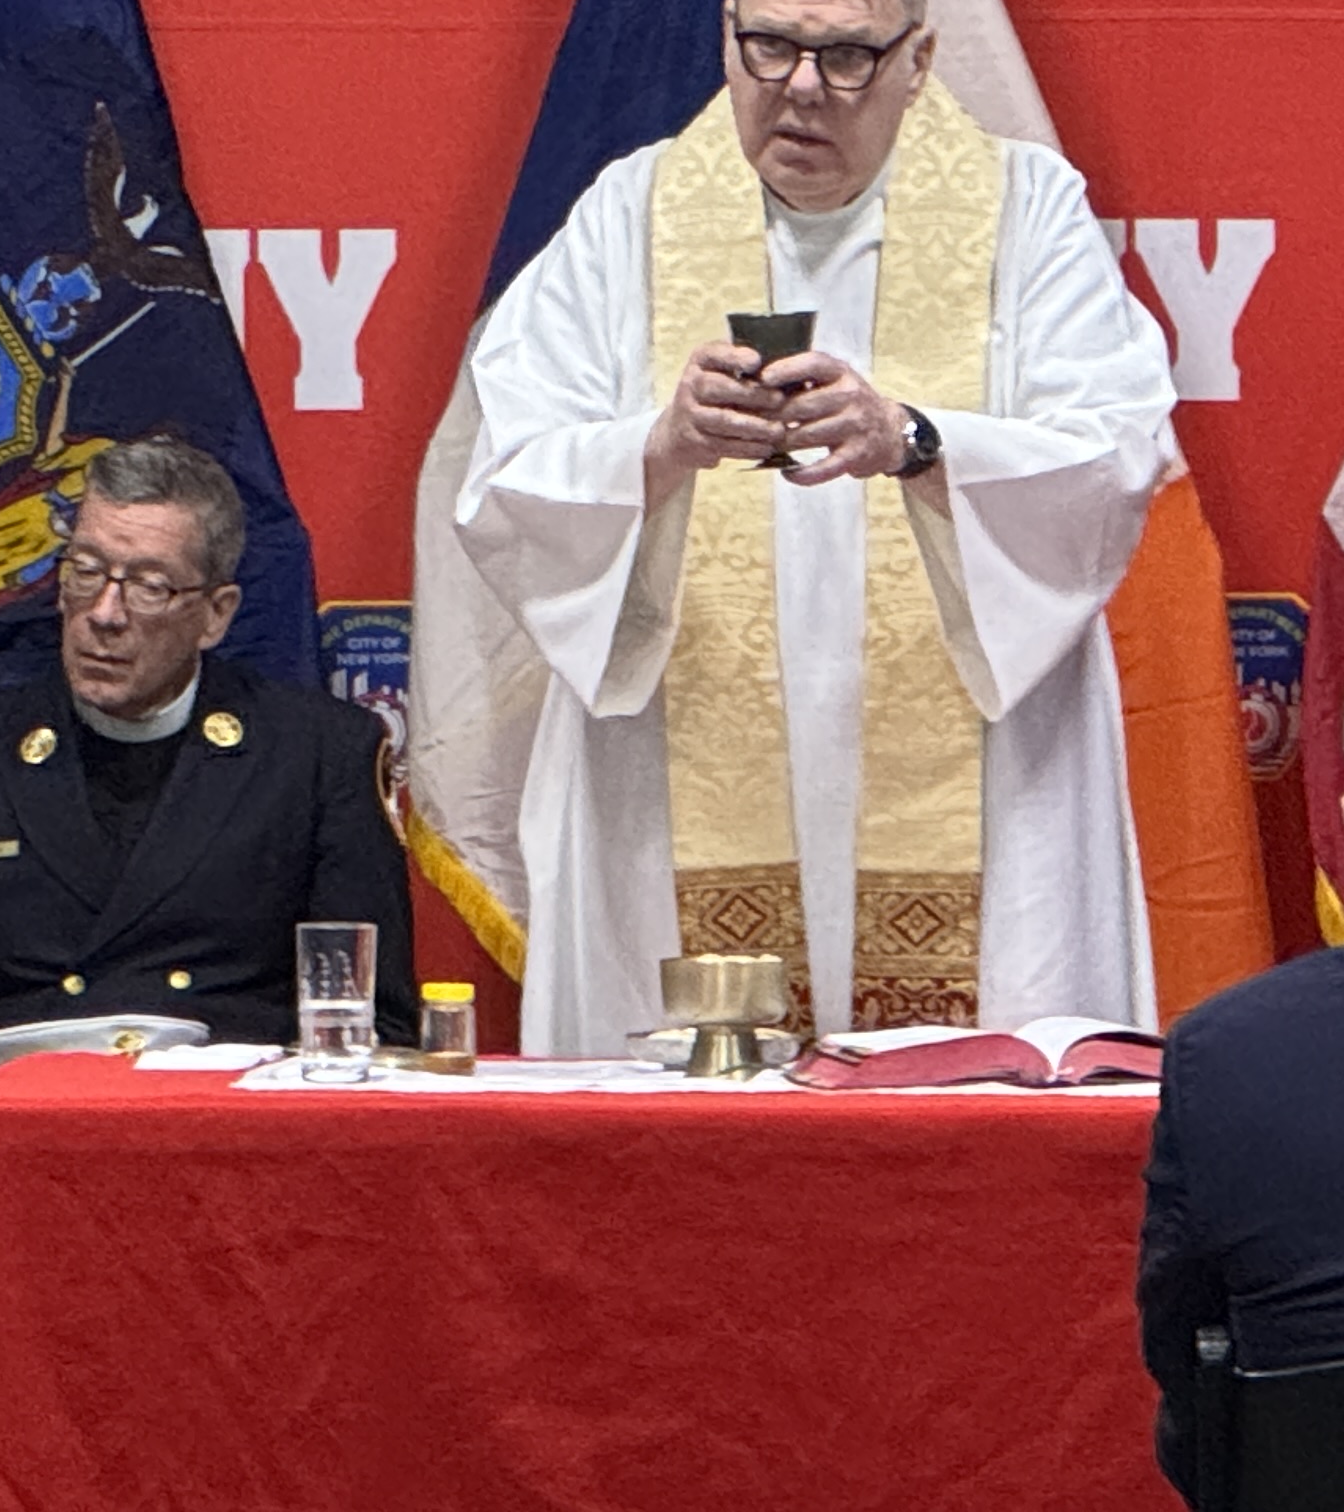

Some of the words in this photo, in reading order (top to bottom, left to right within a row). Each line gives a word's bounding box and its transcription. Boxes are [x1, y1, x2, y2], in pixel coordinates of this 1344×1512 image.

[347, 636, 379, 650] CITY
[381, 636, 403, 650] OF
[336, 653, 370, 666] NEW
